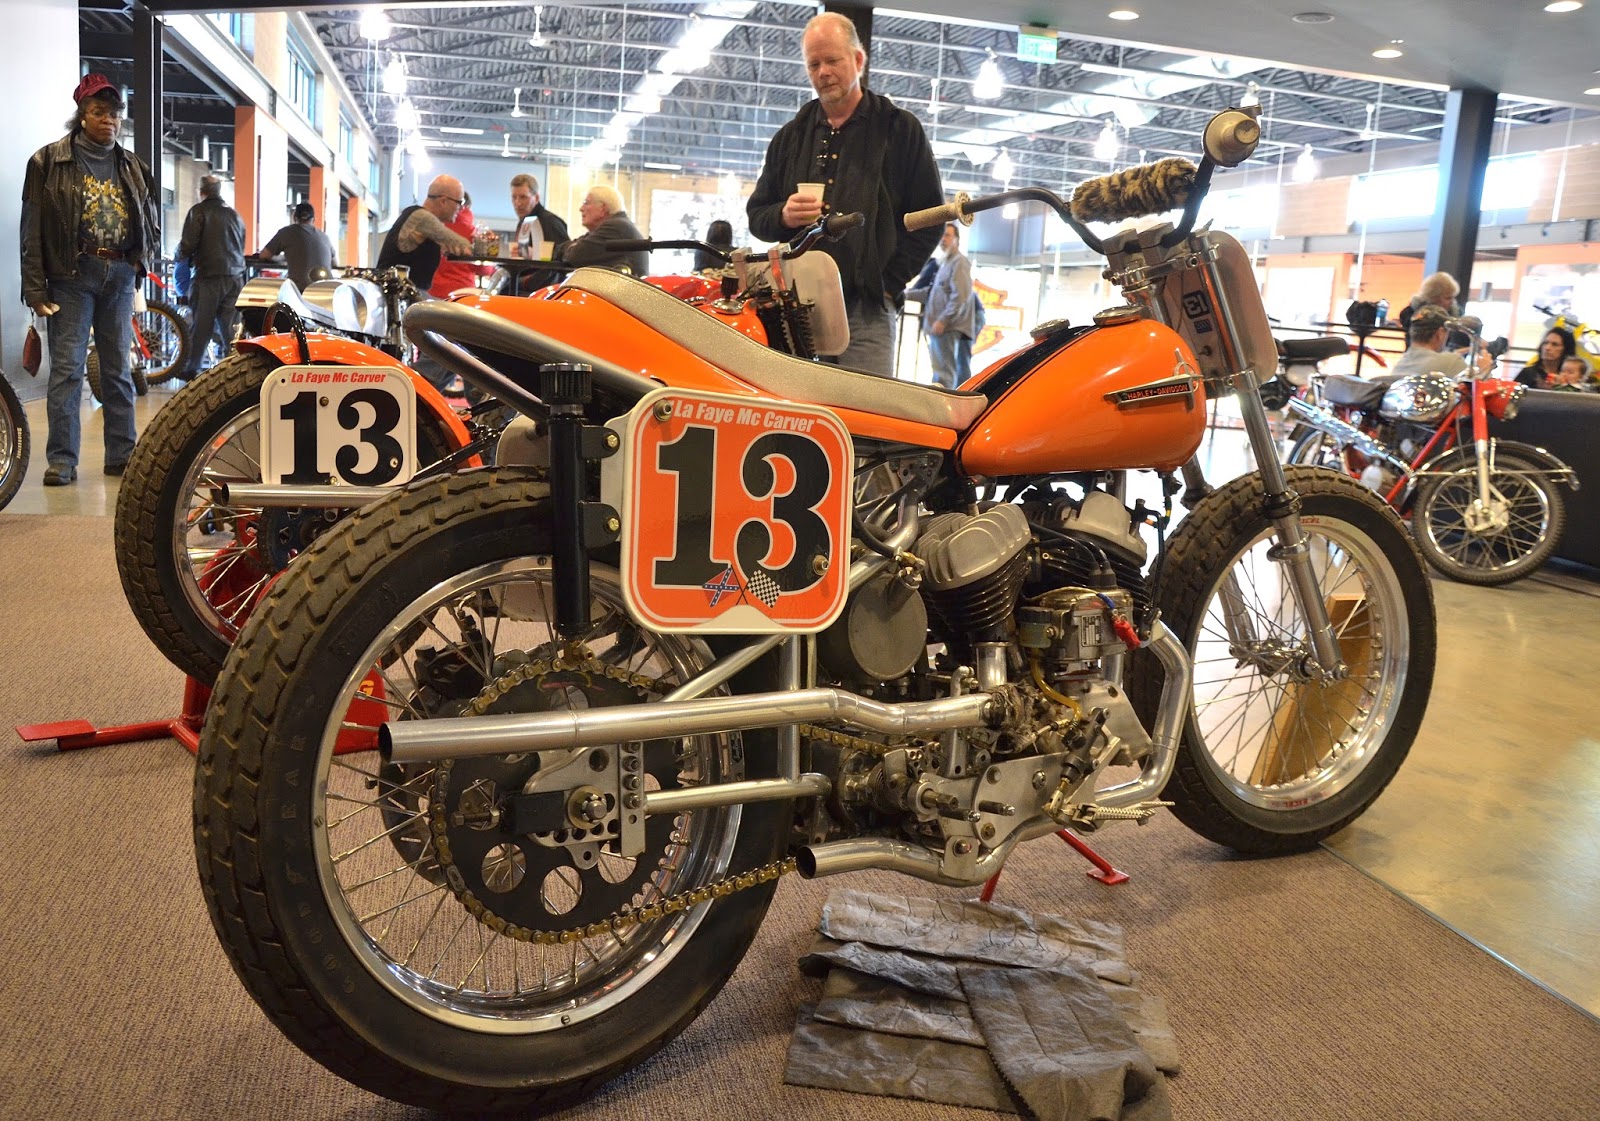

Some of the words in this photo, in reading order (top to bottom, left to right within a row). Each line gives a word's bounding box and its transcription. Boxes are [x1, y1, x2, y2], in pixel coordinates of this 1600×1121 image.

[291, 372, 304, 383] La
[305, 372, 331, 384] Faye
[332, 372, 349, 383] Mc
[350, 372, 387, 383] Carver
[1127, 384, 1188, 400] HARLEY-DAVIDSON
[674, 400, 695, 418] La
[695, 402, 735, 424] Faye
[736, 406, 762, 426] Mc
[763, 411, 815, 433] Carver
[280, 388, 404, 487] 13
[652, 423, 833, 596] 13
